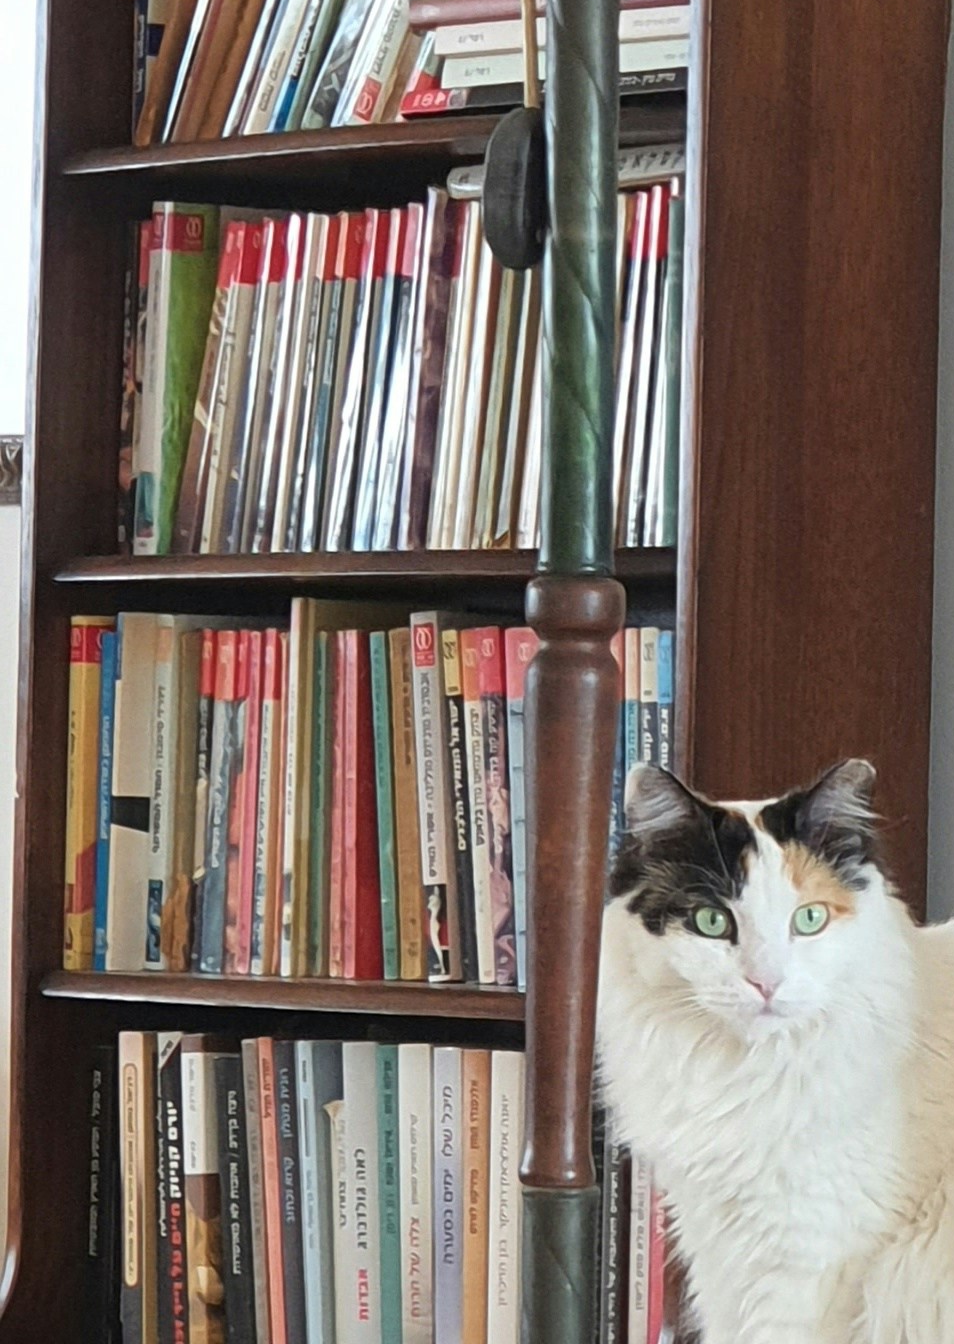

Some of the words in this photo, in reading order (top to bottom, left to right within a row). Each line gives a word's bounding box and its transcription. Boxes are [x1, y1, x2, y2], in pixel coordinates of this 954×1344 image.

[279, 1068, 291, 1099] רונית
[166, 1101, 179, 1140] יורם
[279, 1103, 295, 1139] מטלון
[439, 1085, 454, 1124] מיכל
[168, 1146, 182, 1199] קניוק
[353, 1147, 367, 1181] לאה
[441, 1169, 455, 1203] ימים
[170, 1203, 182, 1245] חיים
[228, 1202, 240, 1220] לא
[354, 1186, 369, 1250] גולדברג
[408, 1216, 421, 1248] צלה
[169, 1249, 183, 1278] על
[409, 1252, 421, 1276] של
